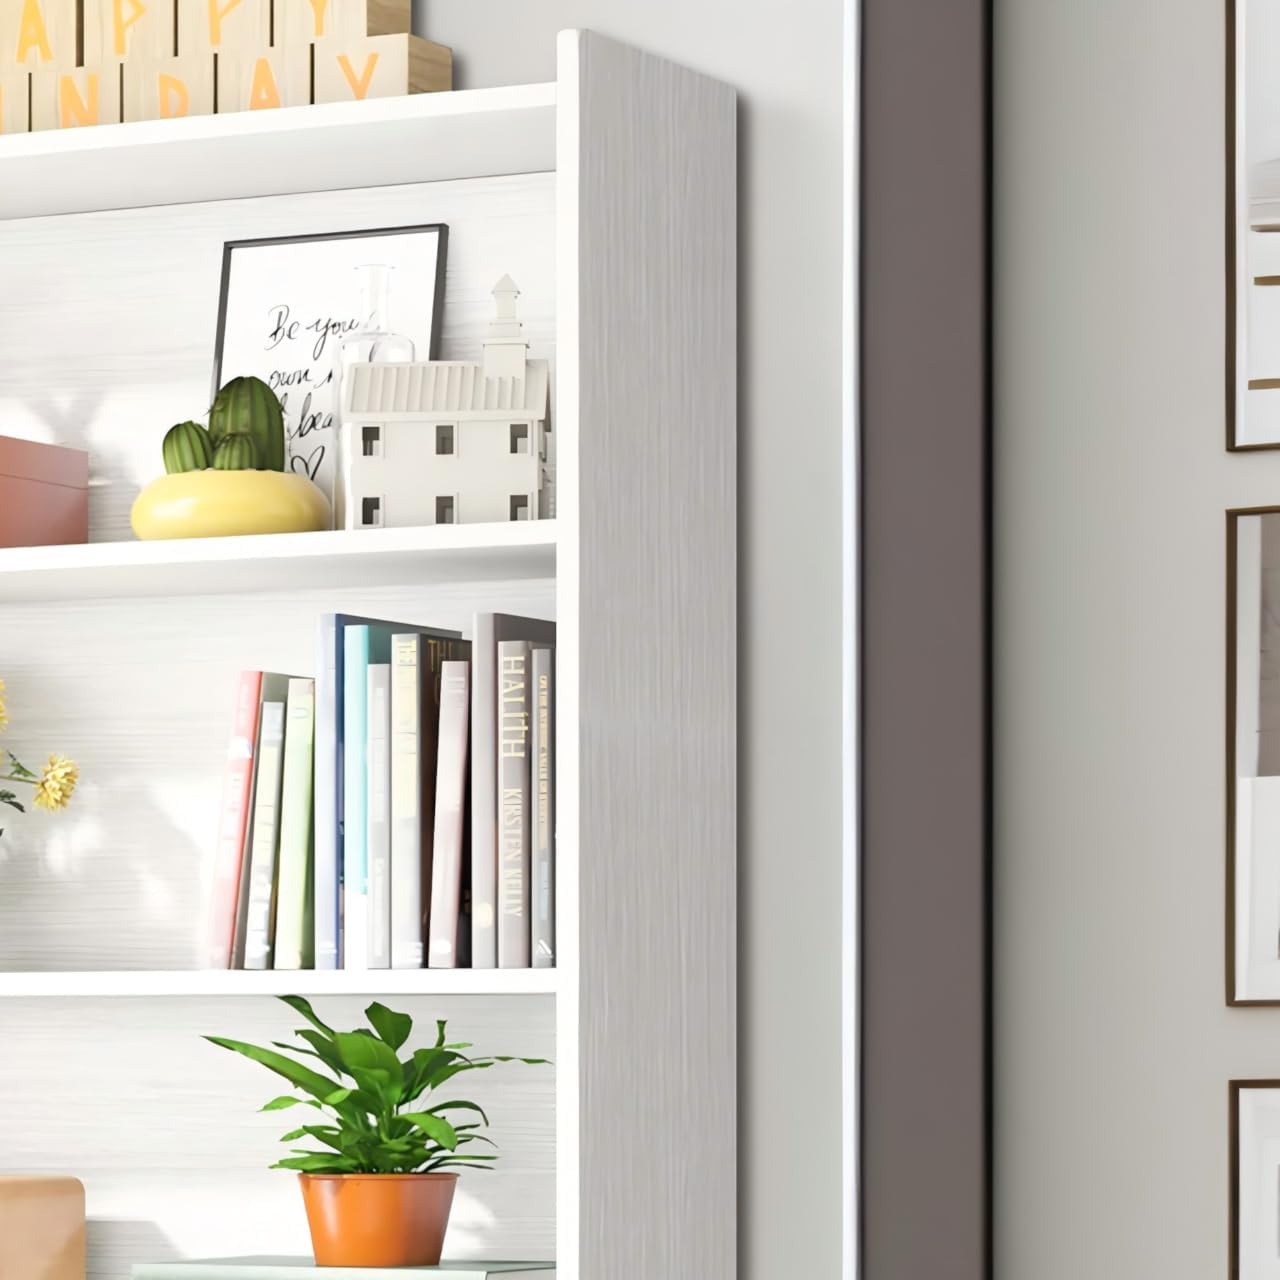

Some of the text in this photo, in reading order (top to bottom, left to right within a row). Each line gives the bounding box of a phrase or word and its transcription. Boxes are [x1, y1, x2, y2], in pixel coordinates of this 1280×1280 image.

[264, 304, 360, 361] Be you
[269, 368, 312, 391] own
